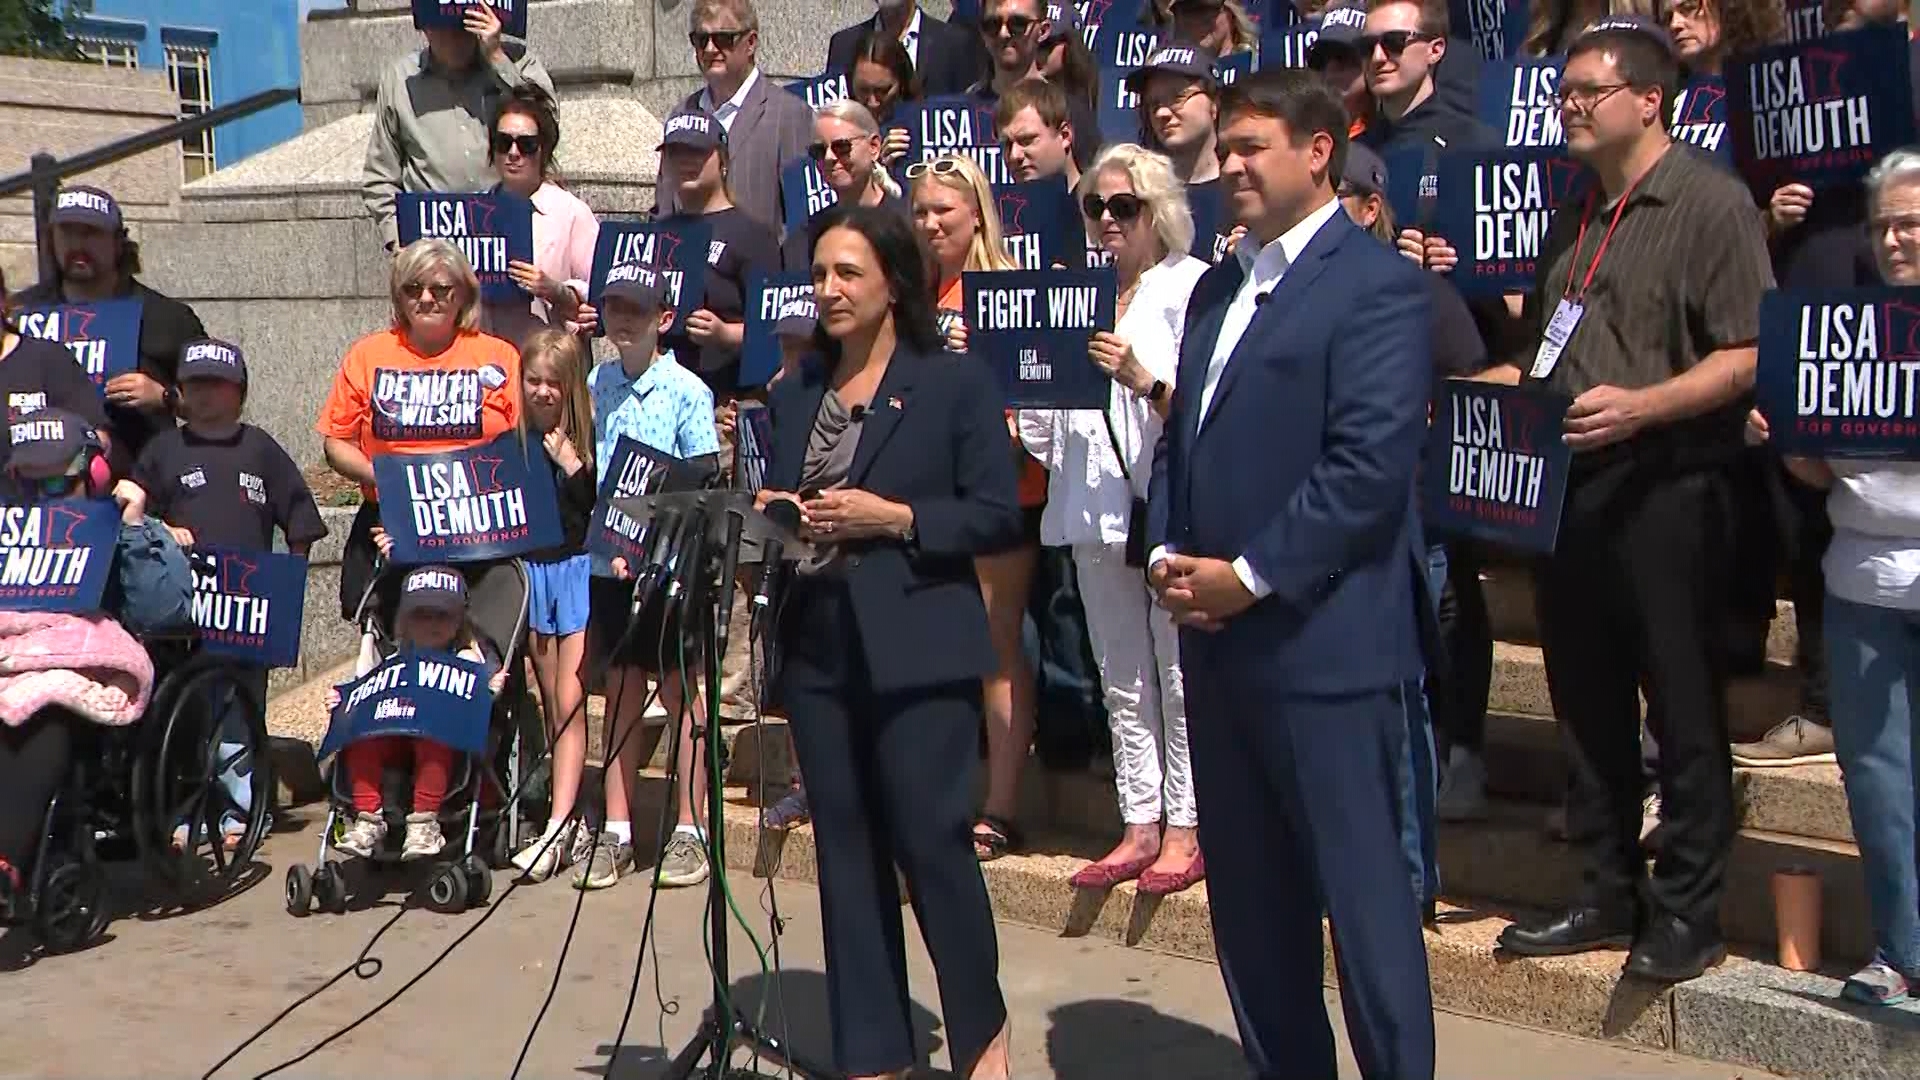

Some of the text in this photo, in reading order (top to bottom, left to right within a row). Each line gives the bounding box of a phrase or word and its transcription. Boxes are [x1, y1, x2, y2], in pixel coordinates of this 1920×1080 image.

[1750, 56, 1804, 112] LISA
[921, 109, 973, 147] LISA
[1753, 96, 1871, 160] DEMUTH
[57, 191, 109, 214] DEMUTH
[1475, 162, 1542, 212] LISA
[419, 201, 467, 236] LISA
[612, 233, 656, 266] LISA
[606, 264, 657, 287] DEMUTH
[19, 312, 60, 342] ISA
[977, 287, 1098, 330] FIGHT. WIN!
[1799, 304, 1877, 360] LISA
[185, 345, 236, 367] DEMUTH
[377, 370, 479, 406] DEMUTH
[1797, 361, 1920, 418] DEMUT
[401, 401, 478, 426] WILSON
[1451, 394, 1502, 449] LISA
[1798, 420, 1832, 436] FOR
[406, 460, 471, 501] LISA
[617, 451, 655, 497] LISA
[1450, 444, 1544, 508] DEMUTH
[0, 507, 41, 547] ISA
[412, 487, 527, 537] DEMUTH
[417, 527, 530, 547] FOR GOVERNOR
[407, 571, 460, 592] DEMUTH
[191, 590, 269, 634] MUTH
[345, 661, 477, 713] FIGHT. WIN!
